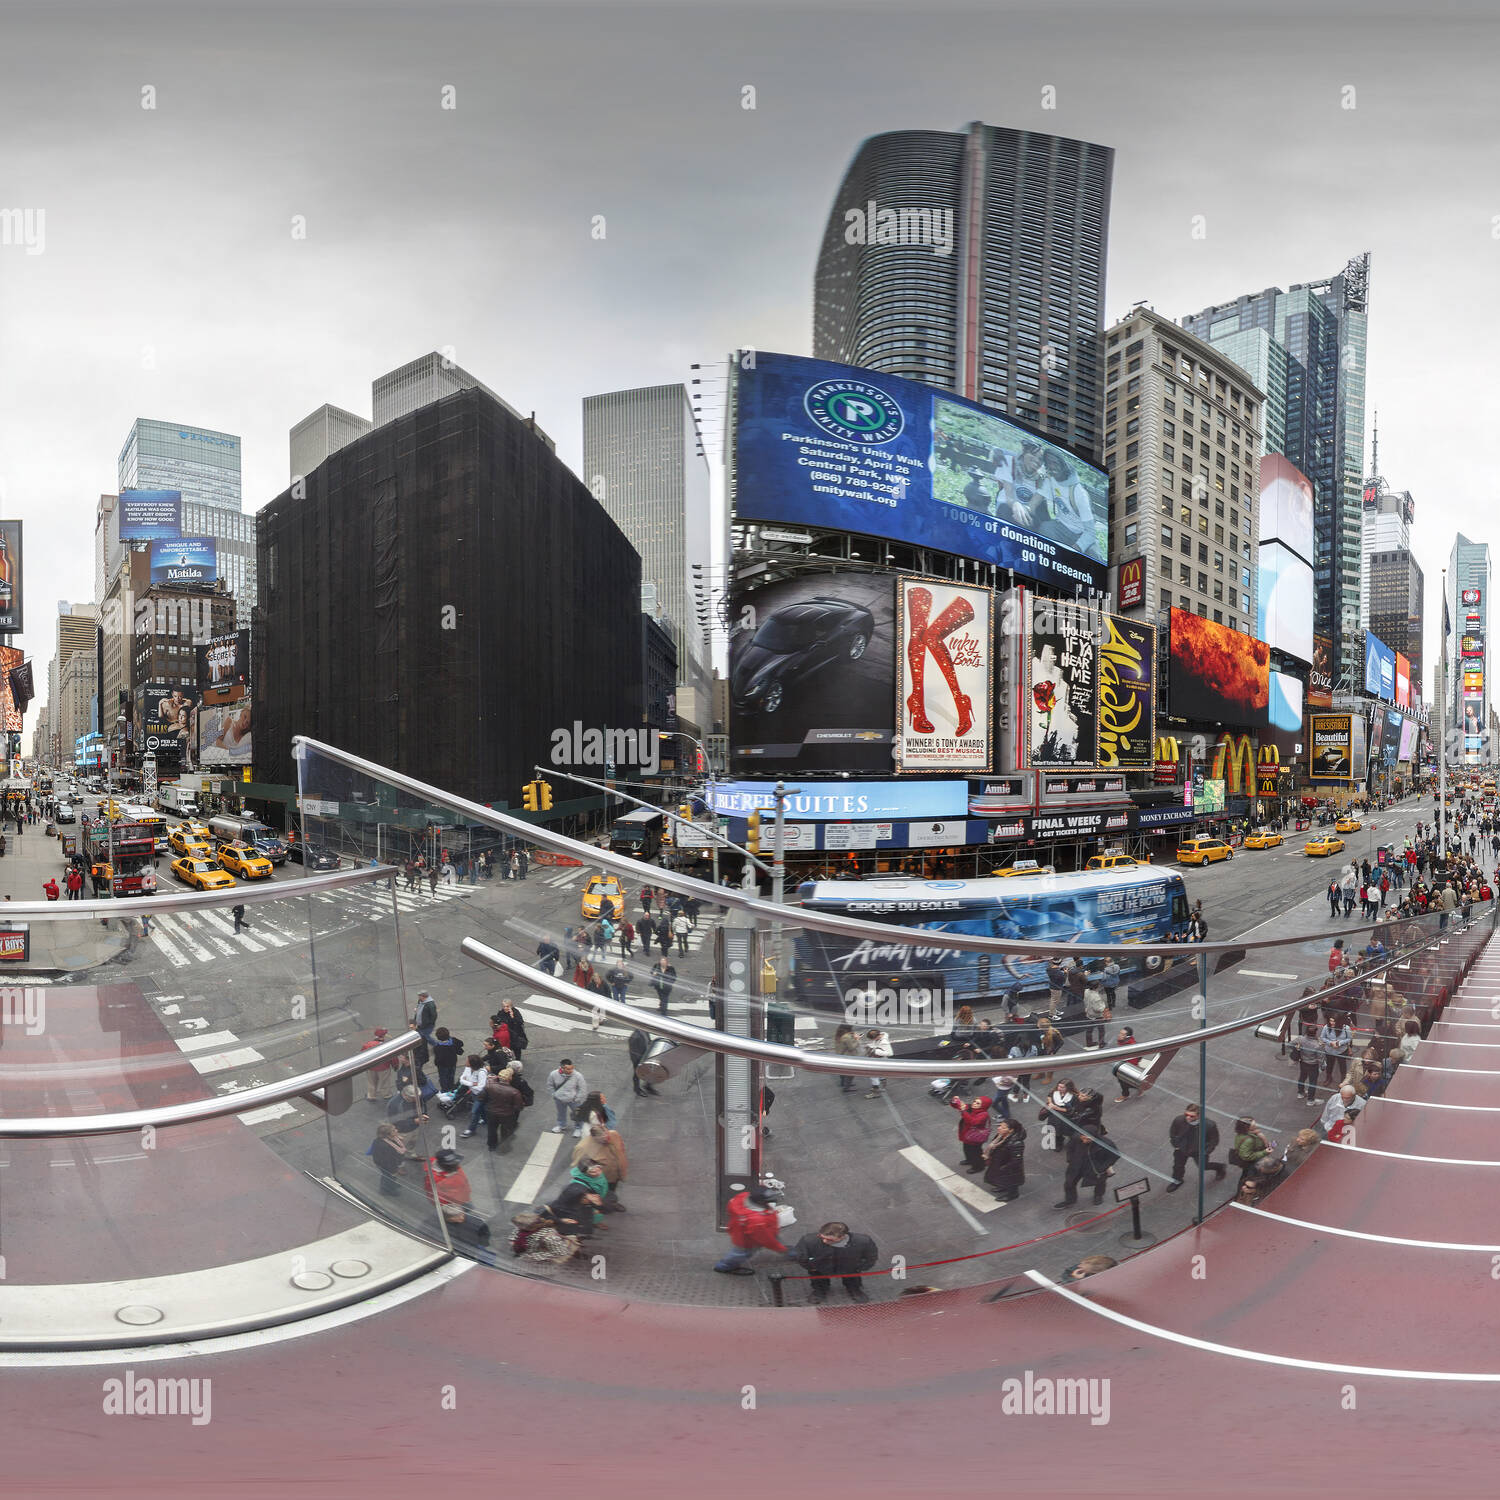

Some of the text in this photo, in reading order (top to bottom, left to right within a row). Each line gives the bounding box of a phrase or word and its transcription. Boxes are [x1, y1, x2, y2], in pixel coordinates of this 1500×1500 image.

[812, 383, 899, 417] PARKINSON'S
[813, 409, 855, 438] UNITY
[781, 433, 924, 468] Parkinson's Unity Walk
[799, 446, 910, 475] Saturday, April 26
[797, 457, 911, 486] Central Park, NYC
[810, 470, 843, 484] (866)
[812, 484, 897, 508] unitywalk.org
[942, 506, 1057, 556] 100% of donations
[167, 569, 202, 578] Matilda
[1021, 549, 1093, 585] go to research
[1123, 581, 1140, 591] OPEN
[1124, 587, 1139, 600] 24
[1060, 620, 1094, 644] HOLLER
[205, 636, 224, 645] DEVIOUS
[1065, 638, 1093, 660] IF YA
[951, 652, 985, 668] Boots
[1061, 652, 1090, 670] HEAR
[1070, 666, 1091, 685] ME
[146, 724, 167, 734] DALLAS
[935, 738, 940, 748] 6
[941, 738, 959, 748] TONY
[959, 739, 984, 748] AWARDS
[1315, 732, 1348, 741] Beautiful
[984, 783, 1011, 794] Annie
[1047, 782, 1068, 793] Annie
[1076, 781, 1096, 792] Annie
[1104, 780, 1123, 791] Annie
[782, 795, 869, 813] SUITES
[1032, 815, 1101, 831] FINAL WEEKS
[1105, 815, 1128, 828] Annie
[1140, 810, 1193, 823] MONEY EXCHANGE
[994, 823, 1024, 837] Annie
[1042, 827, 1093, 837] GET TICKETS HERE
[846, 900, 966, 914] CIRQUE DU SOLEIL
[1125, 899, 1139, 909] THE
[1139, 897, 1152, 907] BIG
[1153, 894, 1166, 904] TOP
